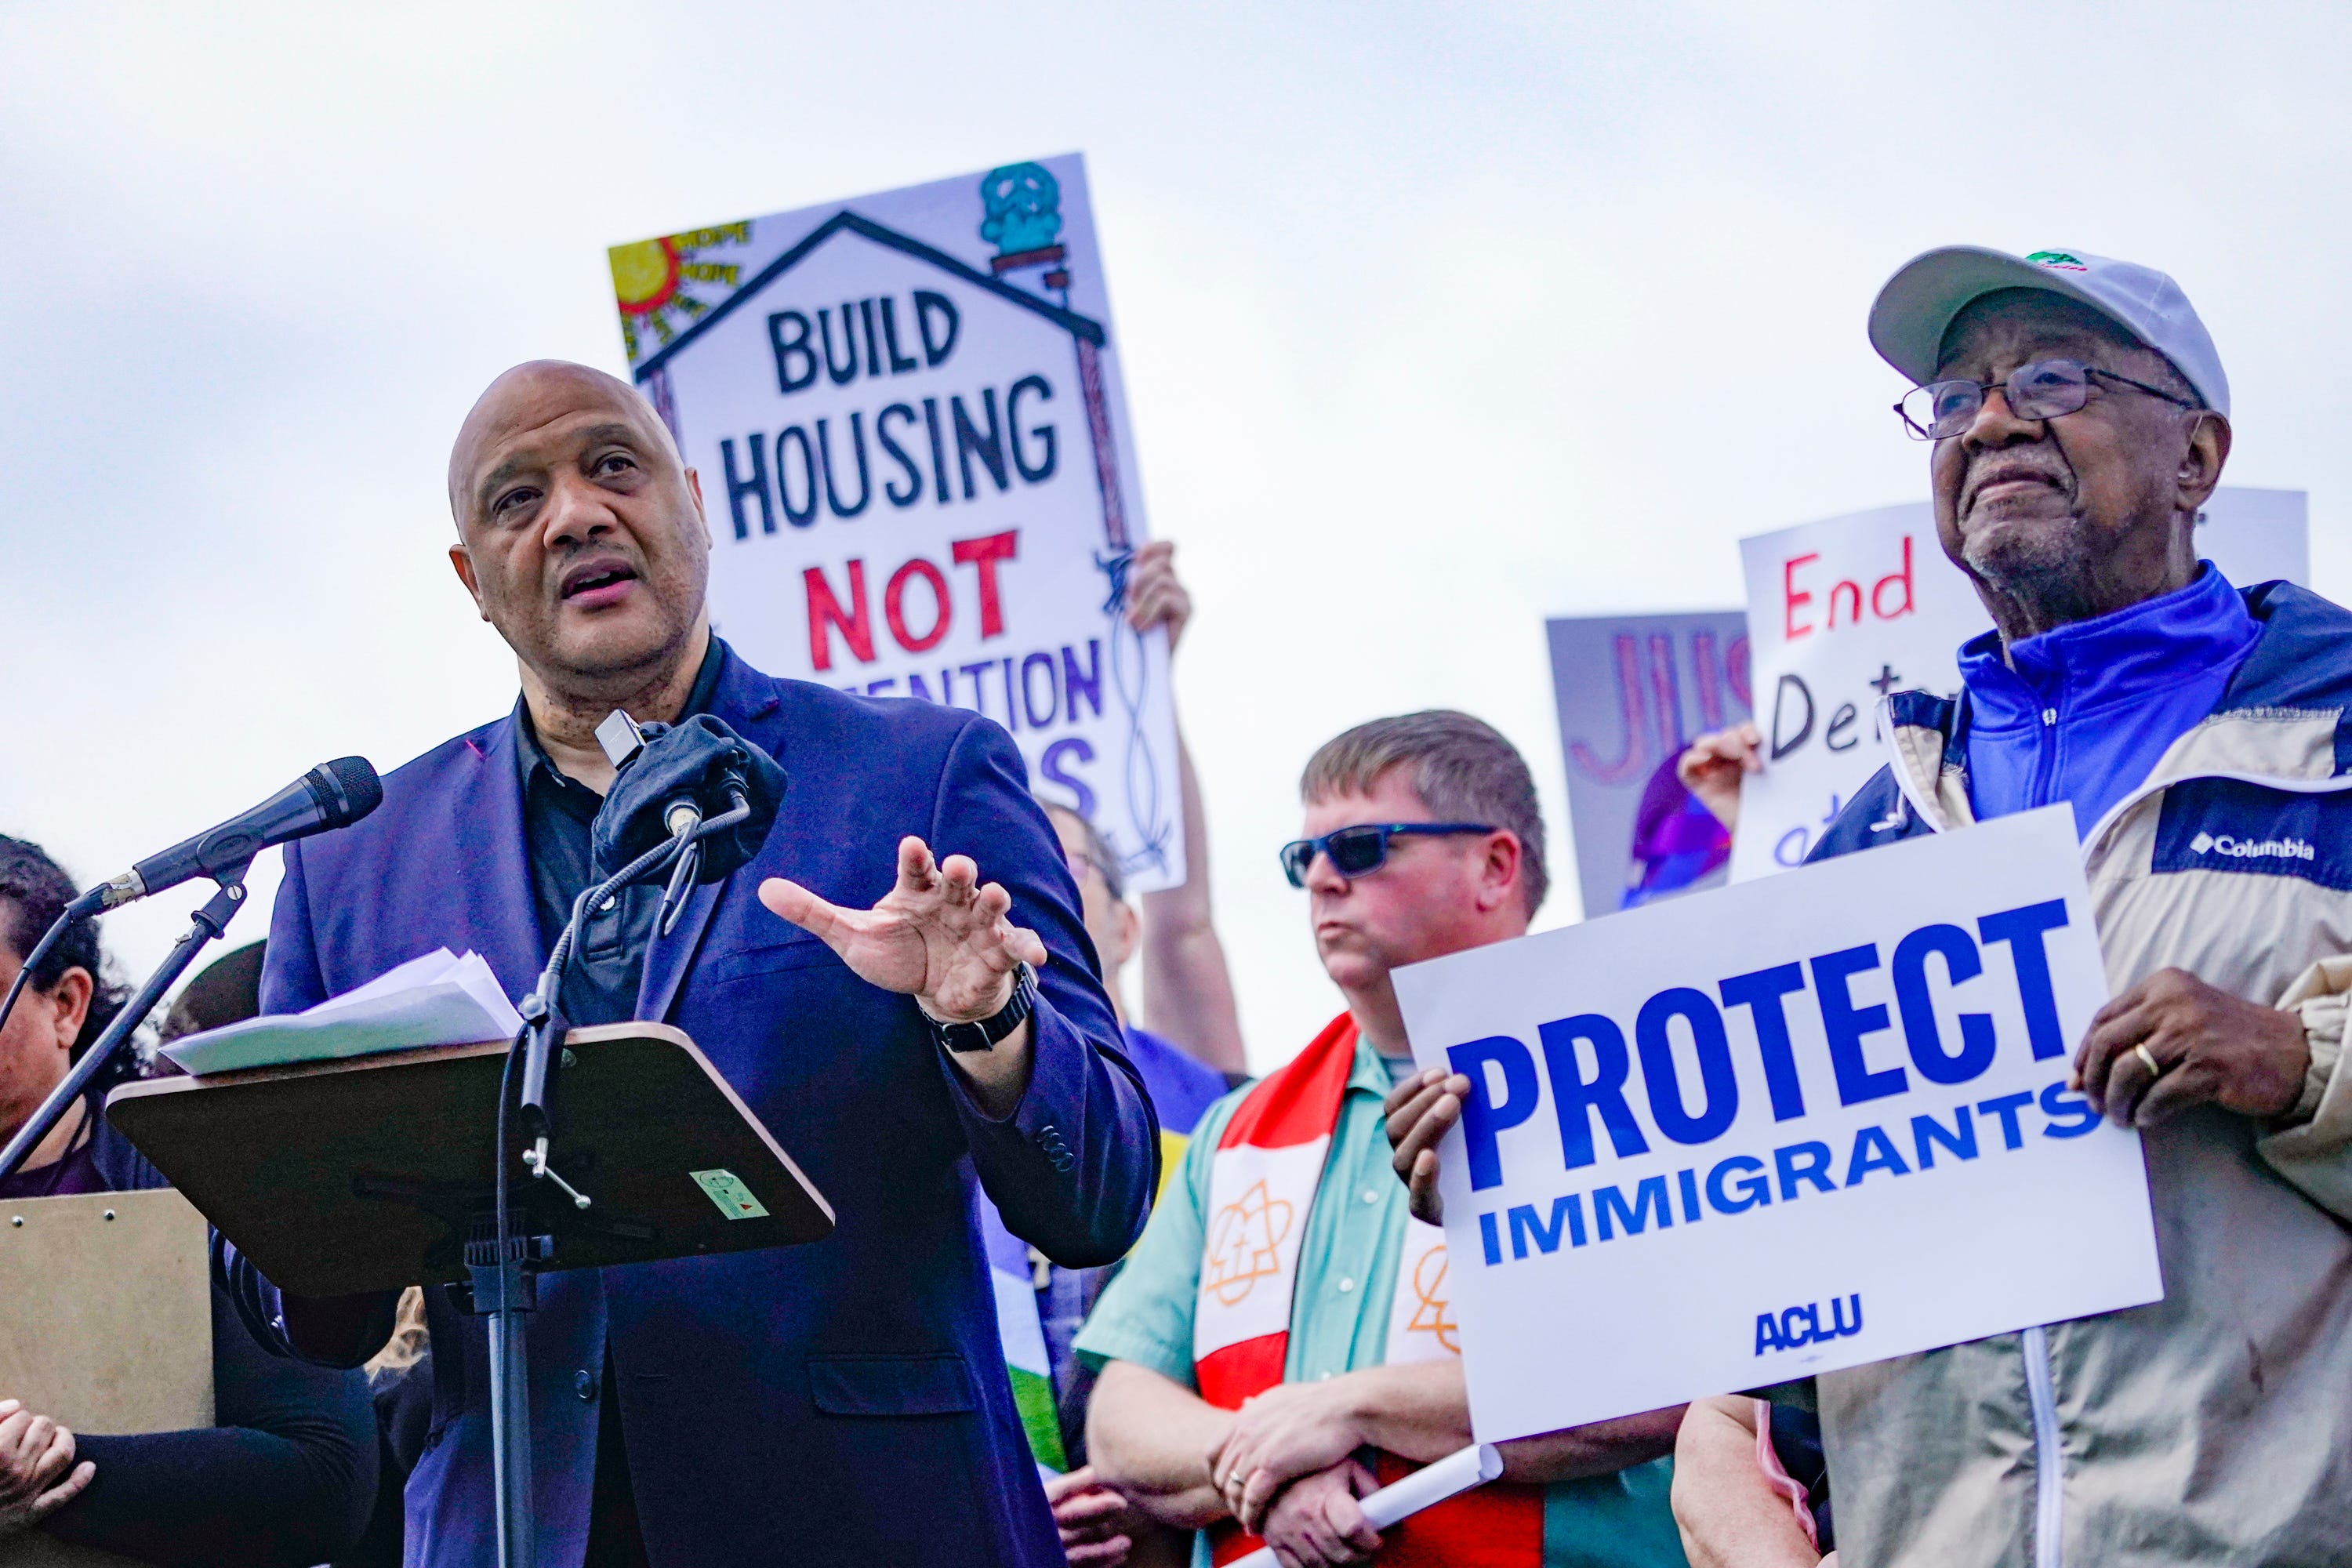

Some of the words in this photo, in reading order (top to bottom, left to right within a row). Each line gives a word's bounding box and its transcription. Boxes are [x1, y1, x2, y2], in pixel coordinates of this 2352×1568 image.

[768, 290, 960, 394] BUILD
[720, 375, 1060, 540] HOUSING
[804, 529, 1018, 671] NOT
[1784, 535, 1915, 641] End
[2214, 834, 2314, 861] Columbia
[1446, 898, 2069, 1192] PROTECT
[1479, 1080, 2103, 1267] IMMIGRANTS
[1755, 1294, 1862, 1358] ACLU
